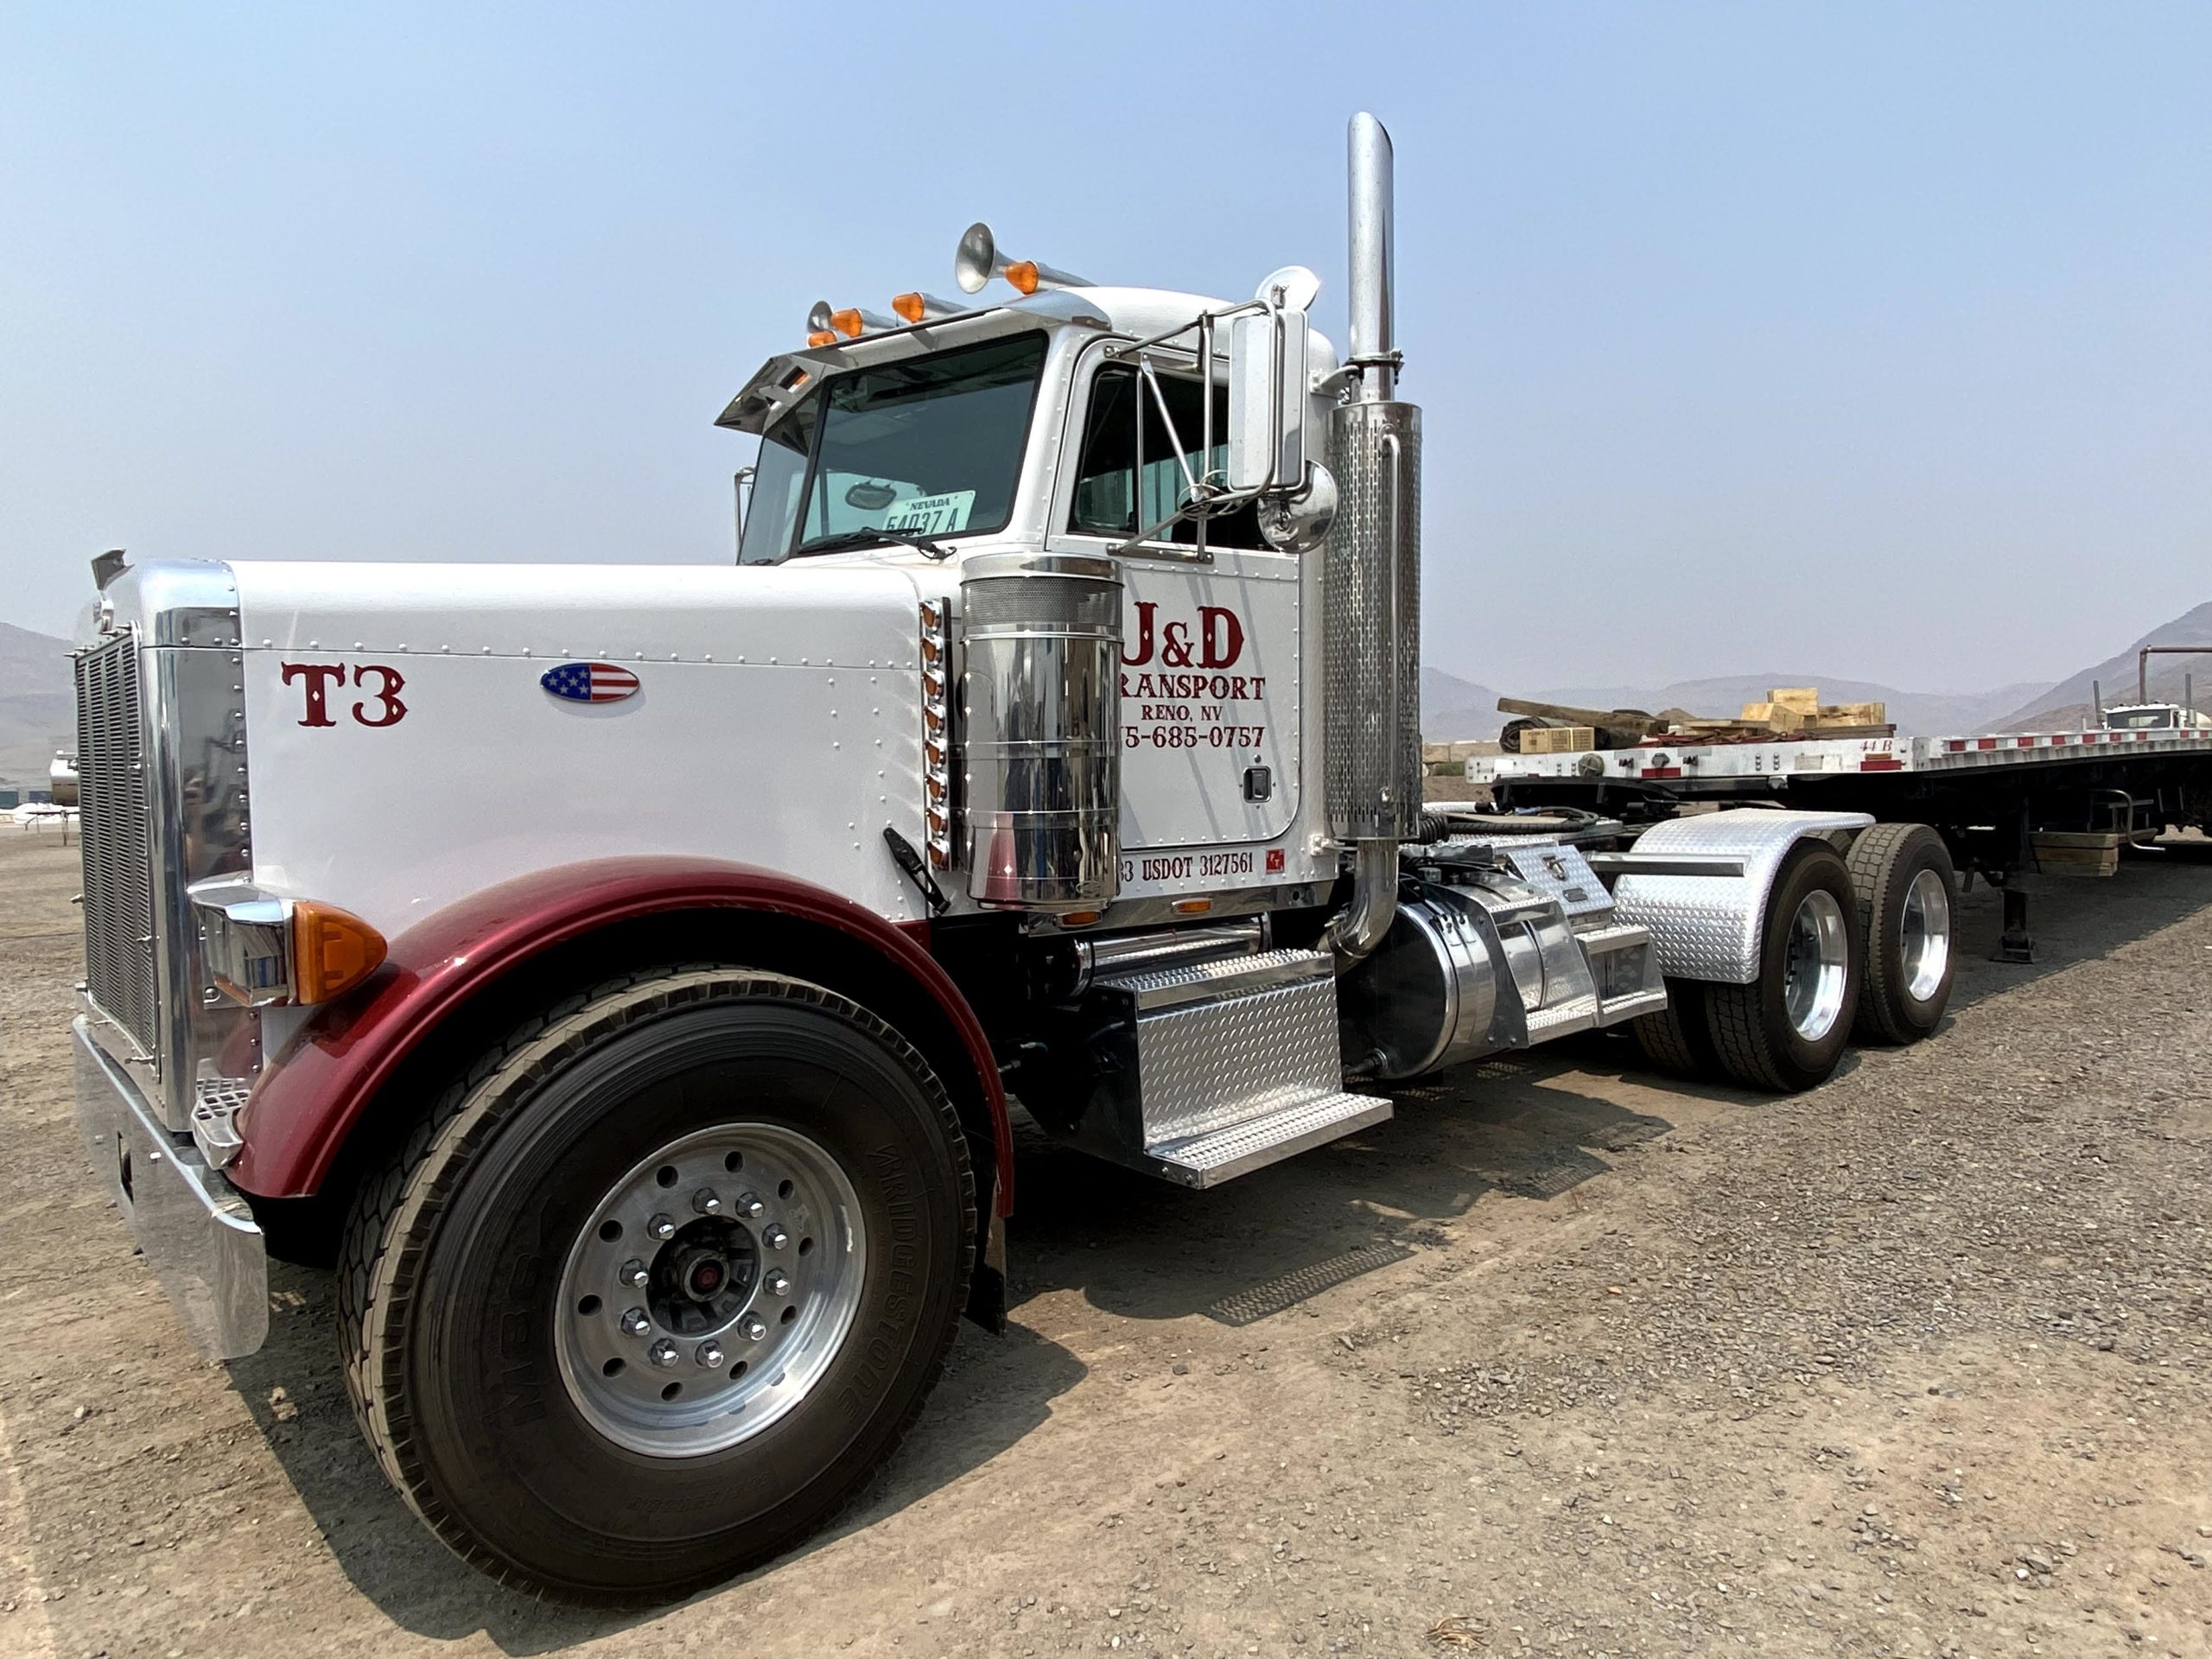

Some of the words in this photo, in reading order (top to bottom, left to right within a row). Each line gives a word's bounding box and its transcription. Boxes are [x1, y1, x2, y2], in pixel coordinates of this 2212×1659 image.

[910, 497, 950, 512] NEVADA
[945, 507, 959, 532] A
[1122, 601, 1245, 670] J&D
[281, 661, 408, 728] T3
[1120, 672, 1267, 701] RANSPORT
[1141, 704, 1194, 723] RENO,
[1200, 705, 1224, 721] NV
[1121, 725, 1266, 749] 5-685-0757
[1882, 740, 1893, 752] B
[1141, 856, 1193, 880] USDOT
[1199, 851, 1254, 876] 3127561
